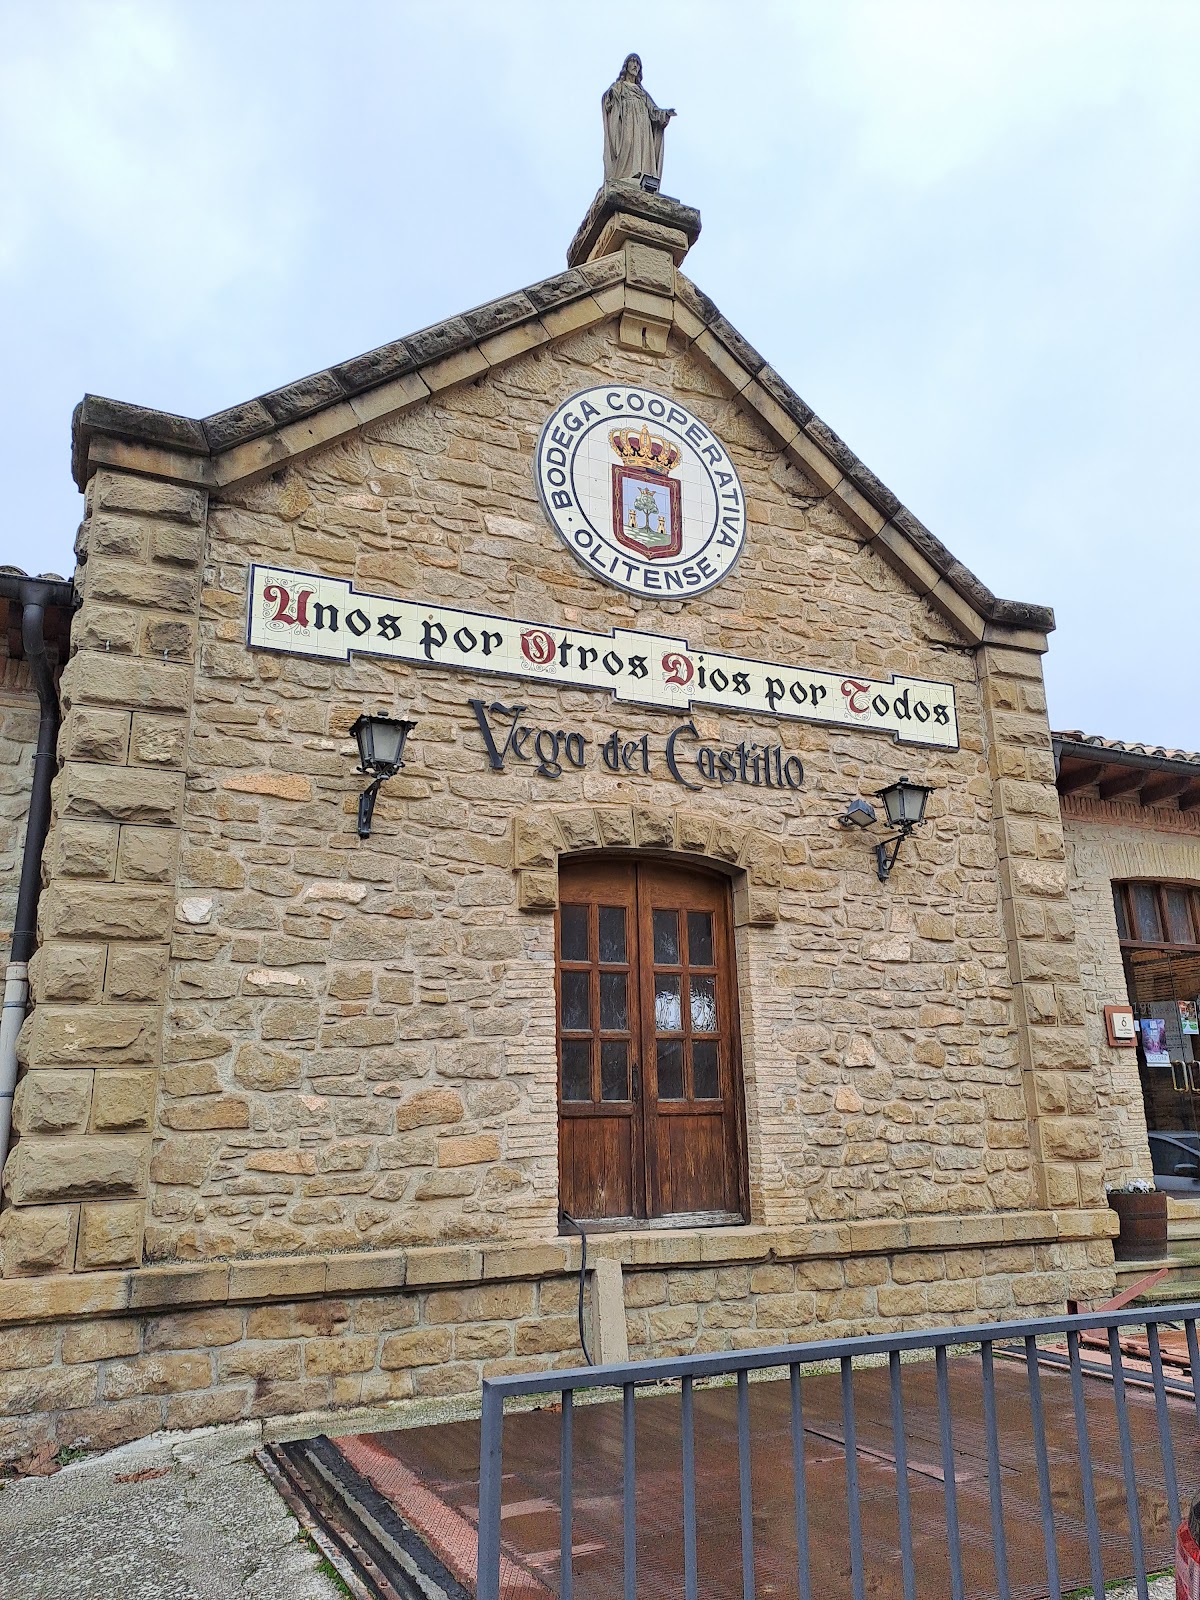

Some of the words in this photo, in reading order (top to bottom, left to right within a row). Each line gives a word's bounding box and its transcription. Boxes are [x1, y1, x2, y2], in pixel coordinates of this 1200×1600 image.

[547, 400, 600, 510] BODEGA
[606, 392, 740, 548] COOPERATIVA
[574, 529, 718, 590] OLITENSE
[262, 581, 402, 641] Unos
[419, 619, 503, 660] por
[520, 628, 649, 680] Otros
[661, 652, 750, 695] Dios
[765, 674, 827, 711] por
[840, 679, 950, 726] Todos
[468, 699, 586, 779] Vega
[599, 730, 649, 774] del
[665, 720, 805, 792] Castillo
